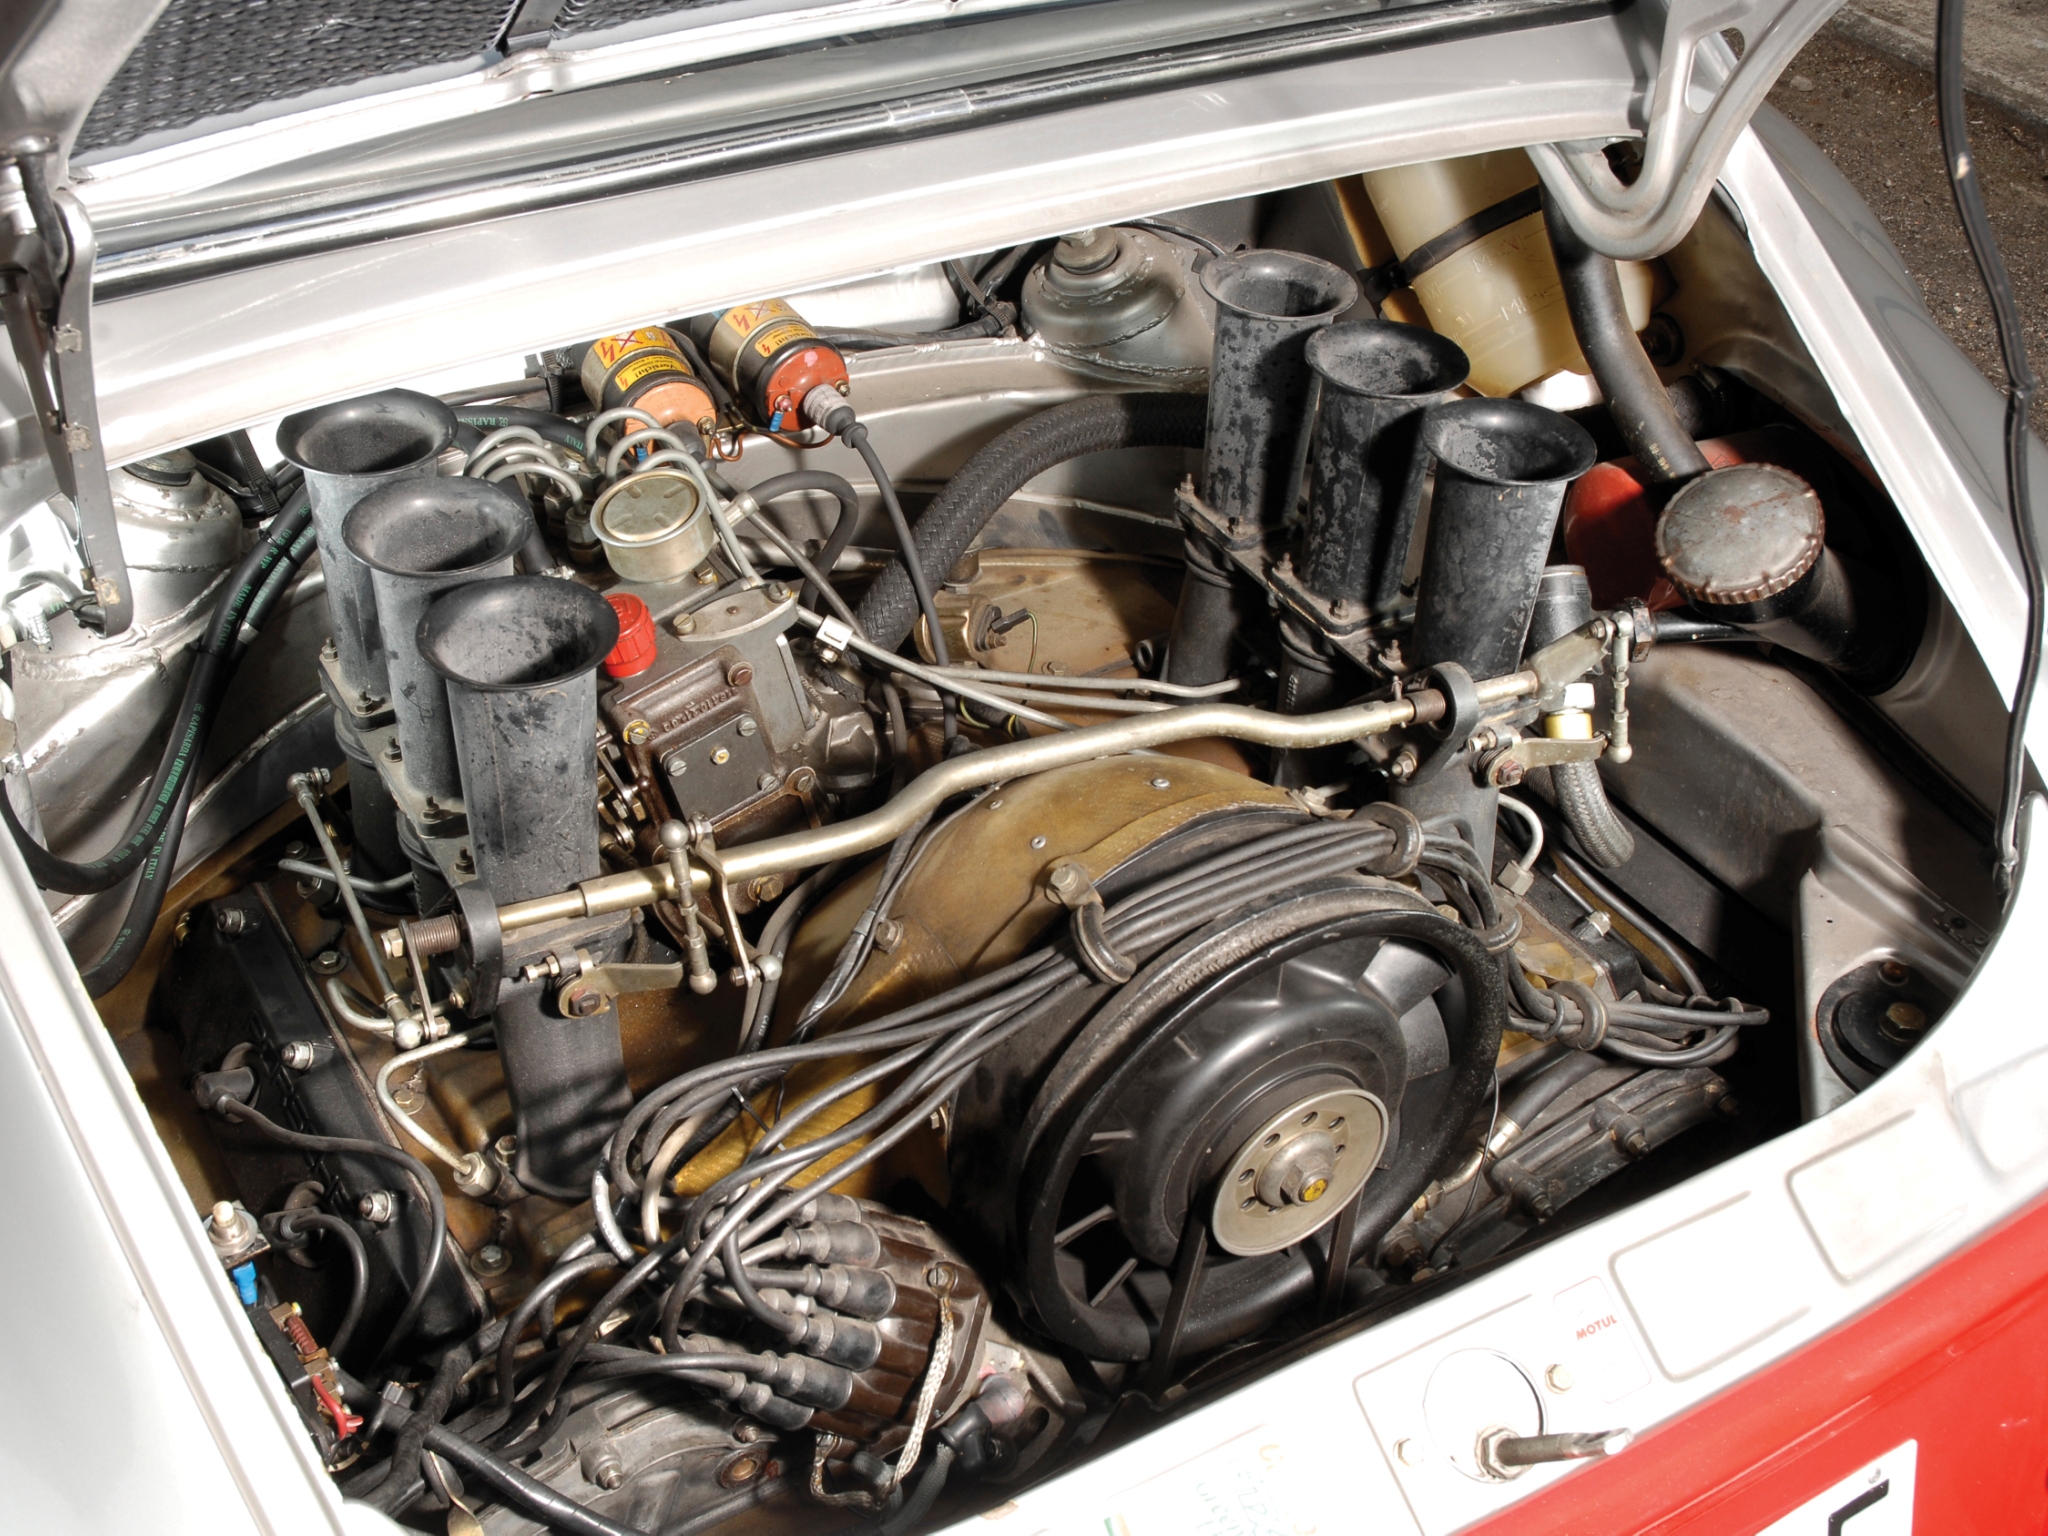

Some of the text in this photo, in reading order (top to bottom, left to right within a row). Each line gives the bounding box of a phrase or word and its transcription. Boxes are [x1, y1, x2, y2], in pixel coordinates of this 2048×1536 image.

[565, 434, 584, 450] ITALY
[299, 501, 311, 517] OSE
[282, 528, 292, 539] 10
[260, 555, 272, 569] WP
[234, 583, 251, 609] MADE
[227, 611, 237, 622] IN
[217, 625, 231, 648] ITALY
[178, 714, 200, 757] RAPISARDA
[153, 846, 161, 855] IN
[144, 857, 157, 880] ITALY
[1576, 1314, 1617, 1340] MOTUL
